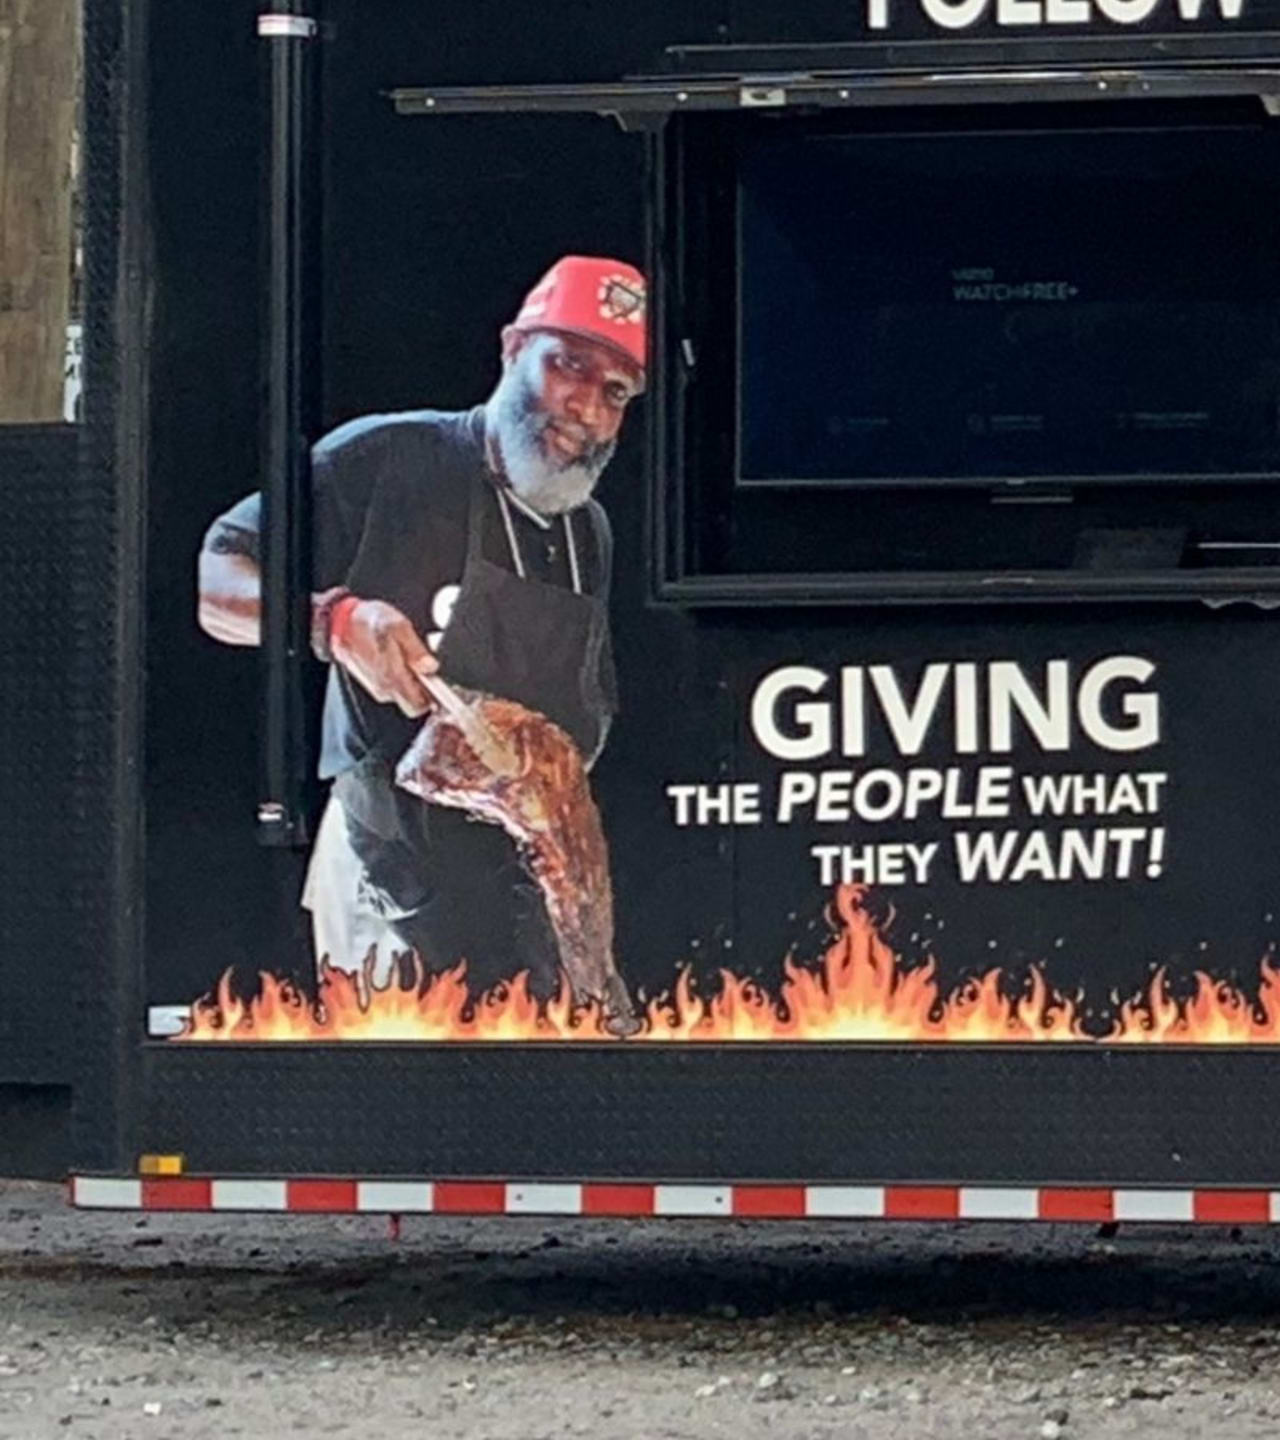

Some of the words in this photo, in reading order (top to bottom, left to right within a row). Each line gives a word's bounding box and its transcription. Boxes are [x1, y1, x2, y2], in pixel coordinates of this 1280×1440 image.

[751, 656, 1160, 760] GIVING
[667, 783, 761, 825] THE
[777, 766, 1013, 823] PEOPLE
[1022, 772, 1167, 815] WHAT
[811, 843, 938, 886] THEY
[955, 827, 1165, 882] WANT!
